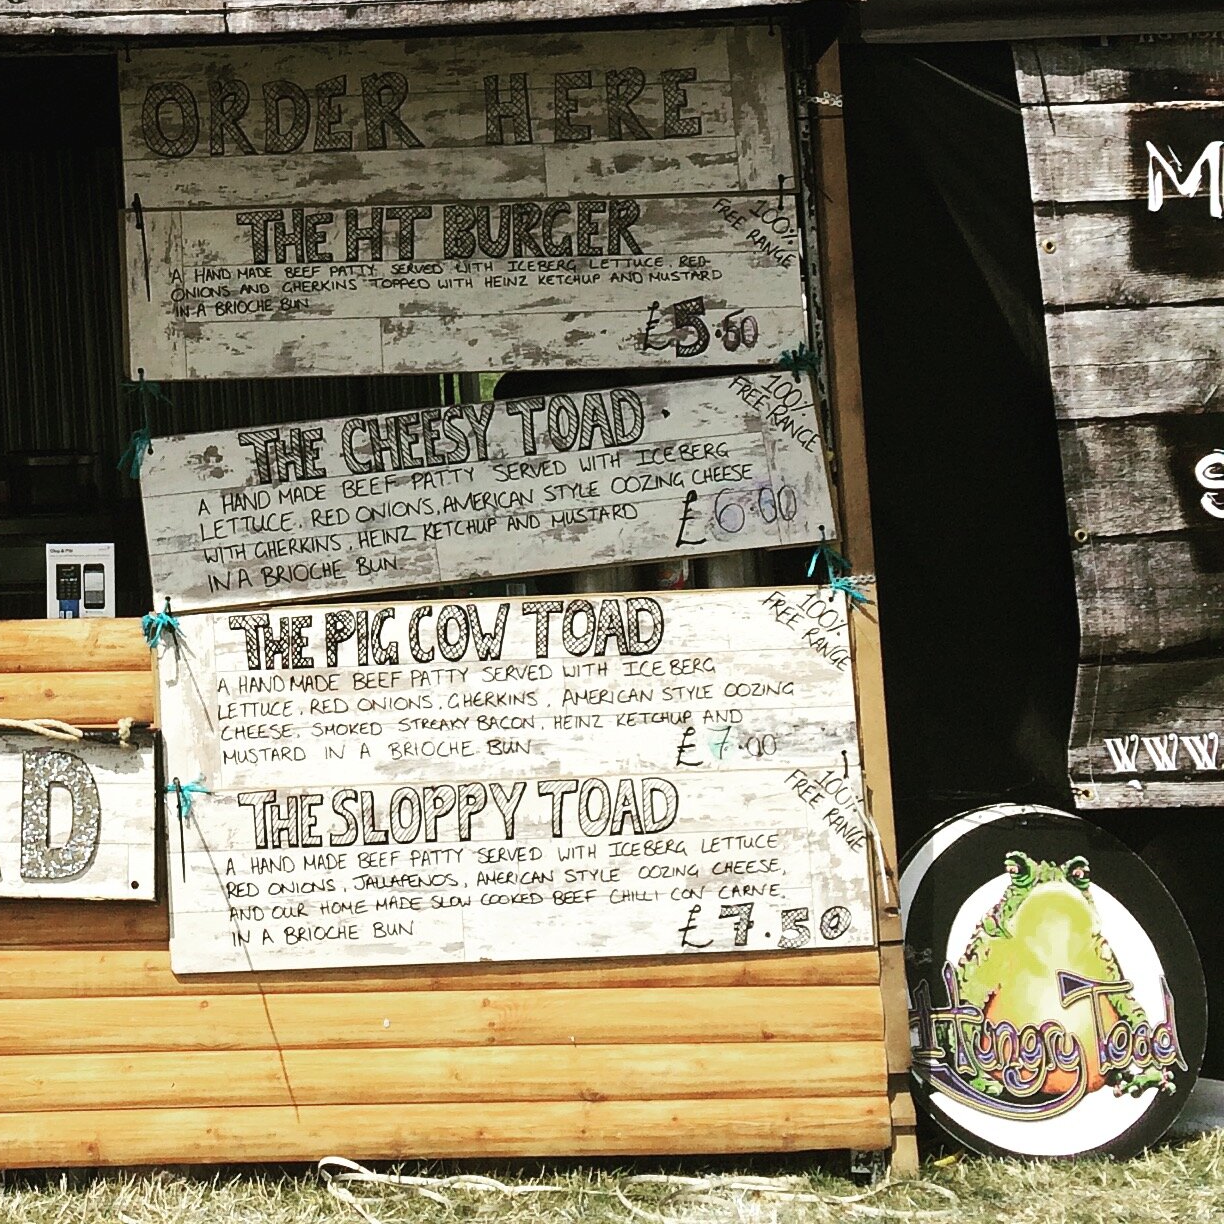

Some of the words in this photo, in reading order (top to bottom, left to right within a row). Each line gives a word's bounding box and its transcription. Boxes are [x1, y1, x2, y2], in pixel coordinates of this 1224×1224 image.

[140, 71, 426, 158] ORDER
[482, 65, 703, 147] HERE
[236, 207, 334, 265] THE
[345, 206, 433, 263] HT
[442, 201, 644, 260] BURGER
[711, 197, 748, 231] FREE
[745, 228, 798, 271] RANGE
[170, 284, 231, 303] ONIONS
[239, 281, 271, 295] AND
[281, 277, 359, 294] GHERKINS
[373, 276, 431, 291] TOPPED
[438, 276, 474, 290] WITH
[484, 274, 529, 289] HEINZ
[537, 272, 602, 286] KETCHUP
[609, 271, 645, 284] AND
[648, 269, 723, 283] MUSTARD
[171, 267, 183, 284] A
[194, 266, 232, 284] HAND
[237, 266, 273, 279] MADE
[284, 265, 321, 278] BEEF
[390, 262, 444, 276] SERVED
[457, 261, 494, 274] WITH
[507, 258, 577, 274] ICEBERG
[215, 298, 274, 316] BRIOCHE
[280, 296, 310, 312] BUN
[238, 427, 327, 485] THE
[341, 403, 496, 476] CHEESY
[506, 388, 645, 457] TOAD
[728, 375, 773, 413] FREE
[765, 404, 821, 454] RANGE
[198, 499, 210, 516] A
[222, 489, 271, 515] HAND
[278, 484, 327, 506] MADE
[343, 474, 398, 499] BEEF
[412, 466, 475, 491] PATTY
[492, 459, 568, 483] SERVED
[579, 451, 621, 473] WITH
[311, 507, 350, 529] RED
[443, 488, 534, 515] AMERICAN
[543, 481, 601, 503] STYLE
[609, 471, 685, 495] OOZING
[691, 463, 754, 484] CHEESE
[203, 543, 247, 565] WITH
[357, 526, 417, 550] HEINZ
[423, 517, 498, 542] KETCHUP
[506, 510, 541, 531] AND
[551, 502, 639, 525] MUSTARD
[207, 573, 231, 594] IN
[238, 569, 253, 589] A
[260, 558, 346, 589] BRIOCHE
[228, 613, 315, 672] THE
[326, 607, 400, 669] PIG
[408, 602, 510, 665] COW
[522, 596, 665, 660] TOAD
[761, 590, 806, 632] FREE
[801, 627, 854, 673] RANGE
[217, 677, 231, 697] A
[353, 669, 403, 691] BEEF
[410, 667, 469, 688] PATTY
[481, 662, 553, 685] SERVED
[562, 658, 609, 679] WITH
[310, 697, 349, 715] RED
[561, 688, 654, 708] AMERICAN
[662, 683, 714, 702] STYLE
[724, 681, 795, 699] OOZING
[312, 721, 383, 738] SMOKED
[398, 715, 470, 733] STREAKY
[553, 713, 604, 730] HEINZ
[616, 708, 693, 728] KETCHUP
[703, 708, 743, 725] AND
[223, 746, 307, 765] MUSTARD
[325, 744, 345, 761] IN
[360, 746, 371, 761] A
[388, 739, 475, 761] BRIOCHE
[486, 738, 532, 756] BUN
[237, 789, 324, 849] THE
[329, 781, 528, 846] SLOPPY
[538, 776, 679, 839] TOAD
[783, 767, 822, 810] FREE
[822, 807, 870, 855] RANGE
[225, 857, 237, 876] A
[250, 855, 296, 875] HAND
[304, 853, 347, 871] MADE
[358, 850, 403, 869] BEEF
[410, 847, 464, 868] PATTY
[477, 845, 542, 864] SERVED
[557, 844, 597, 863] WITH
[608, 839, 688, 858] ICEBERG
[226, 881, 260, 899] RED
[477, 870, 555, 887] AMERICAN
[565, 868, 620, 884] STYLE
[638, 863, 699, 880] OOZING
[229, 906, 264, 922] AND
[271, 903, 309, 919] OUR
[320, 901, 368, 916] HOME
[376, 897, 423, 912] MADE
[431, 894, 471, 909] SLOW
[480, 889, 544, 906] COOKED
[553, 888, 597, 906] BEEF
[609, 888, 660, 904] CHILLI
[671, 886, 705, 902] CON
[678, 902, 853, 950] £7.50
[232, 930, 251, 947] IN
[262, 928, 274, 945] A
[283, 925, 360, 945] BRIOCHE
[373, 919, 415, 939] BUN
